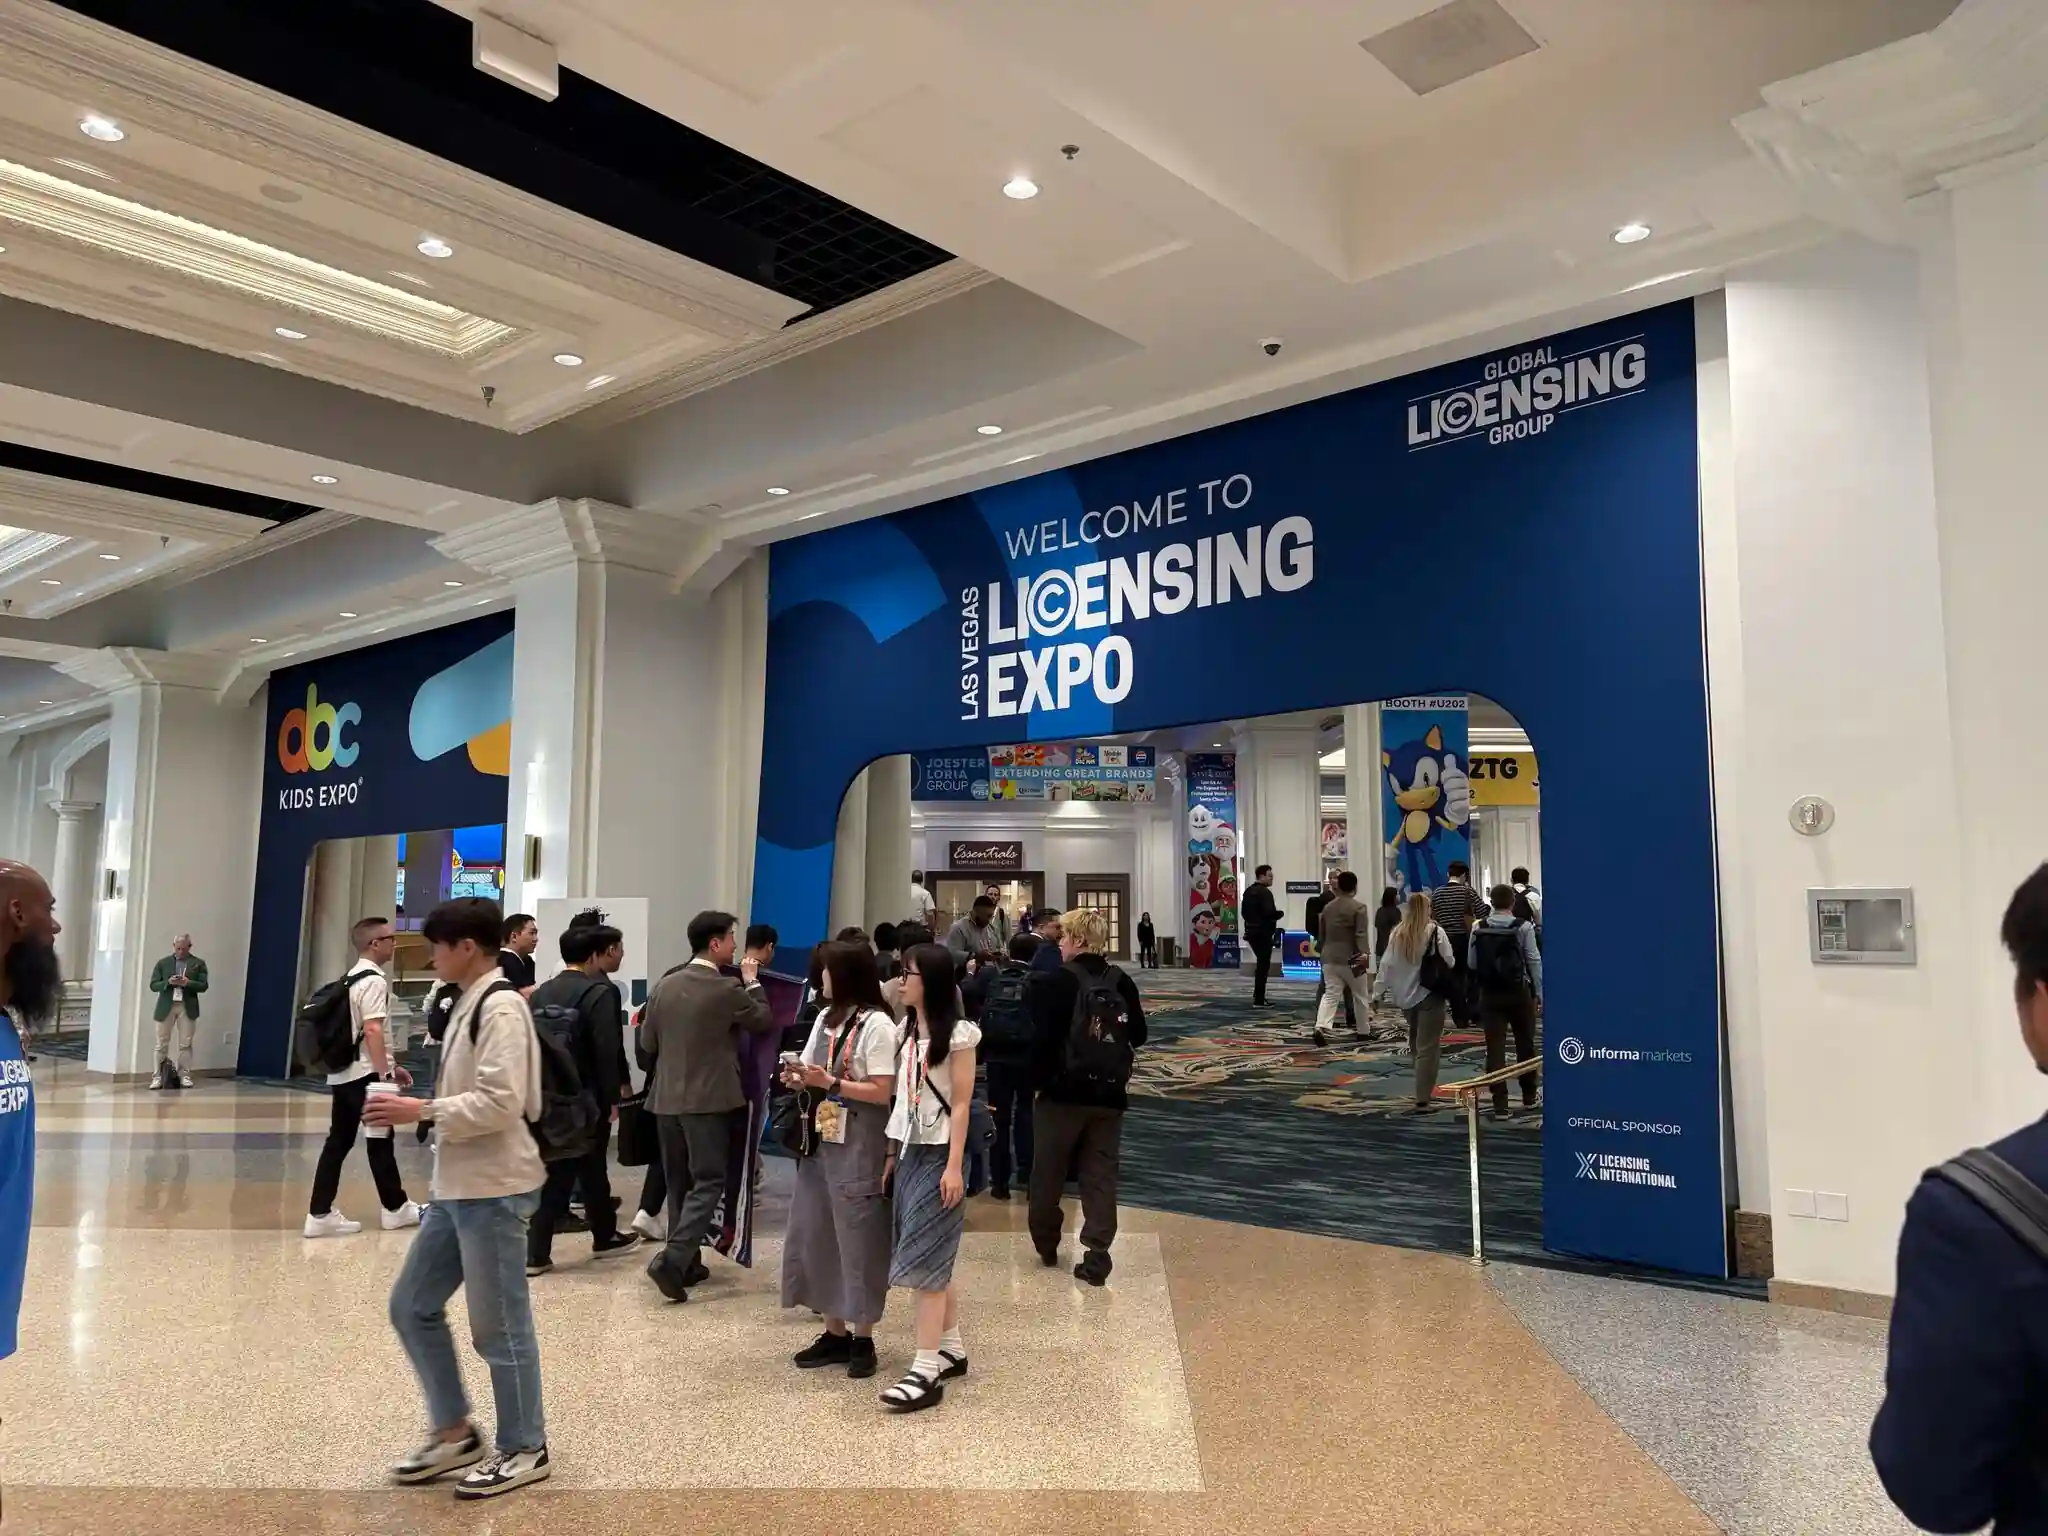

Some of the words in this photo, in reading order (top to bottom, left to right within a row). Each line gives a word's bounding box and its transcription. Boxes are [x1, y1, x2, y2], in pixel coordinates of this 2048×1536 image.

[1484, 346, 1558, 381] GLOBAL
[1489, 413, 1555, 445] GROUP
[1005, 488, 1188, 560] WELCOME
[1199, 473, 1253, 515] TO
[961, 586, 979, 670] VEGAS
[987, 635, 1134, 718] EXPO
[961, 673, 979, 721] LAS
[1385, 699, 1426, 708] BOOTH
[1429, 699, 1465, 709] #U202
[278, 682, 362, 774] abc
[925, 758, 985, 769] JOESTER
[994, 767, 1061, 778] EXTENDING
[1064, 767, 1100, 778] GREAT
[1105, 768, 1153, 779] BRANDS
[926, 770, 968, 780] LORIA
[926, 779, 969, 791] GROUP
[279, 787, 314, 810] KIDS
[954, 844, 1019, 859] Essentials
[1590, 1047, 1640, 1060] informa
[1641, 1049, 1692, 1063] markets
[1568, 1117, 1619, 1130] OFFICIAL
[1622, 1121, 1682, 1136] SPONSOR
[1600, 1154, 1650, 1170] LICENSING
[1600, 1168, 1677, 1188] INTERNATIONAL
